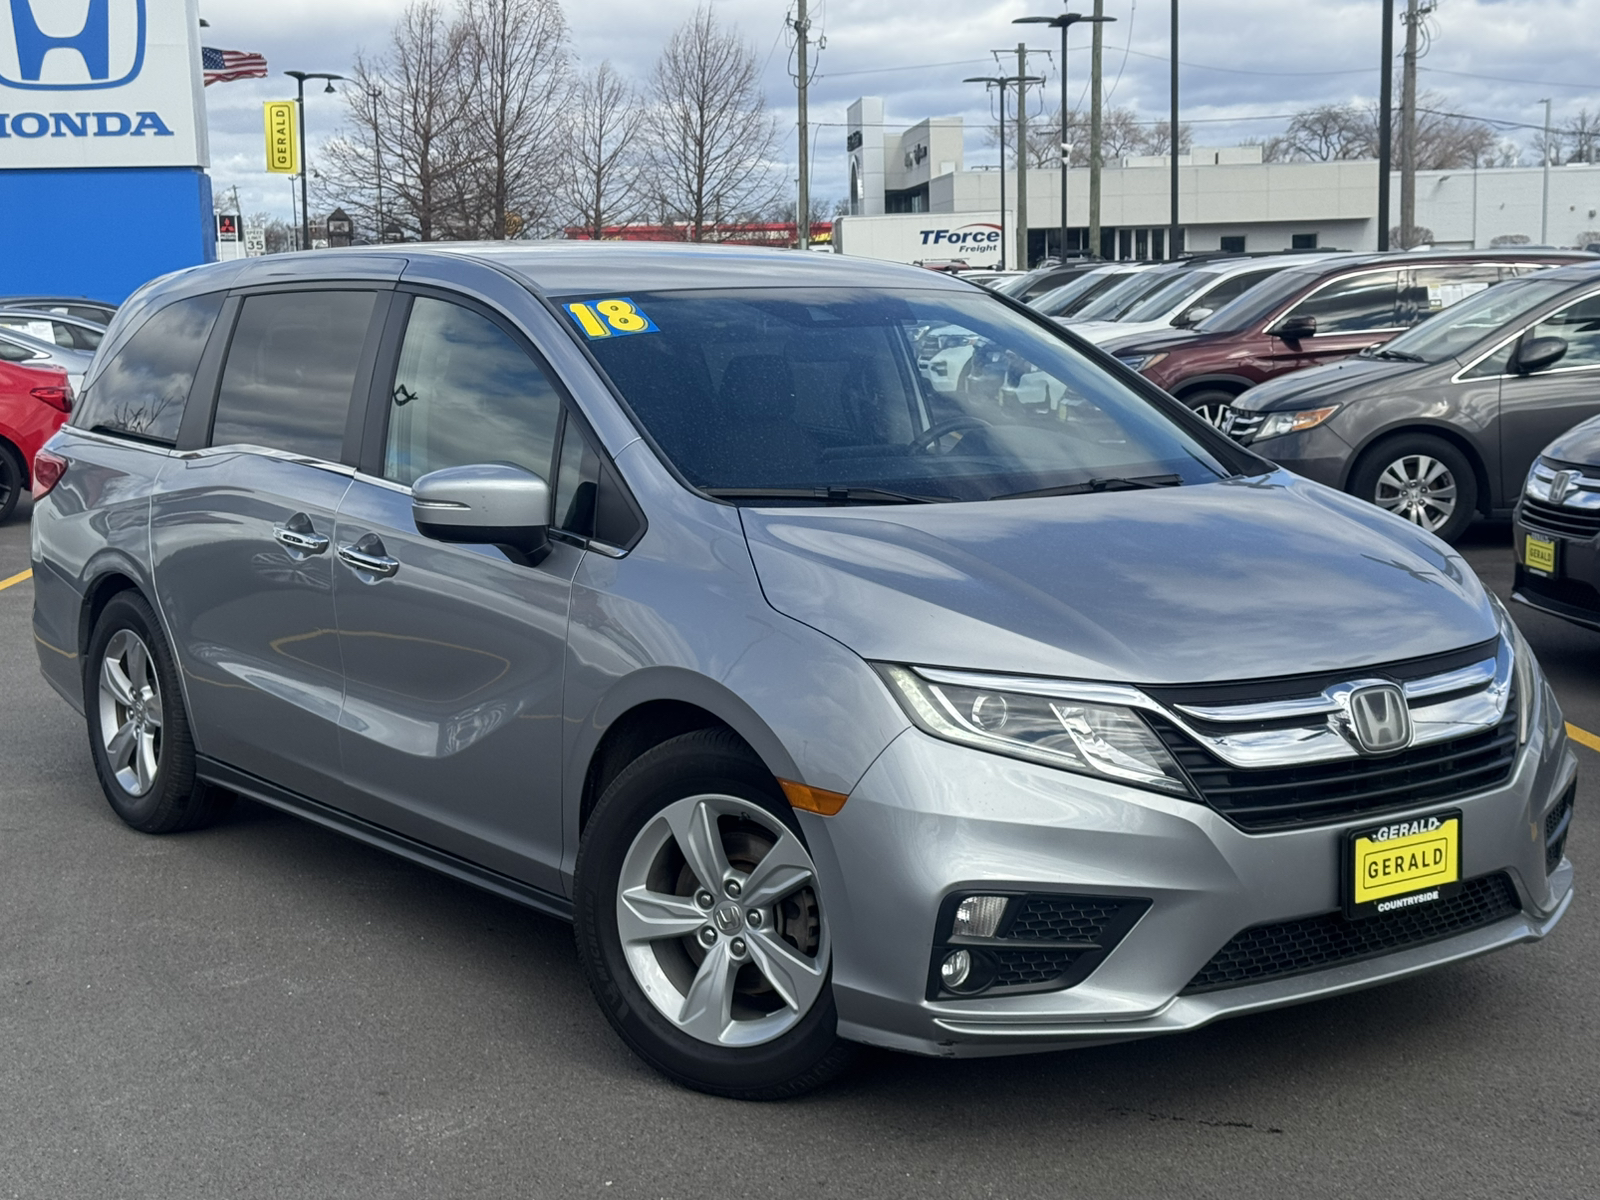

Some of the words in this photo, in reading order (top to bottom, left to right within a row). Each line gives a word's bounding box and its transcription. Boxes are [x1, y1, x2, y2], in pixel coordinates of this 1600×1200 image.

[277, 109, 287, 164] GERALD
[247, 241, 264, 250] 35
[920, 229, 1000, 245] TForce
[959, 244, 997, 254] Freight
[569, 299, 649, 337] 18
[1530, 547, 1551, 562] GERALD
[1377, 817, 1438, 841] GERALD
[1368, 848, 1442, 879] GERALD
[1377, 891, 1439, 912] COUNTRYSIDE
